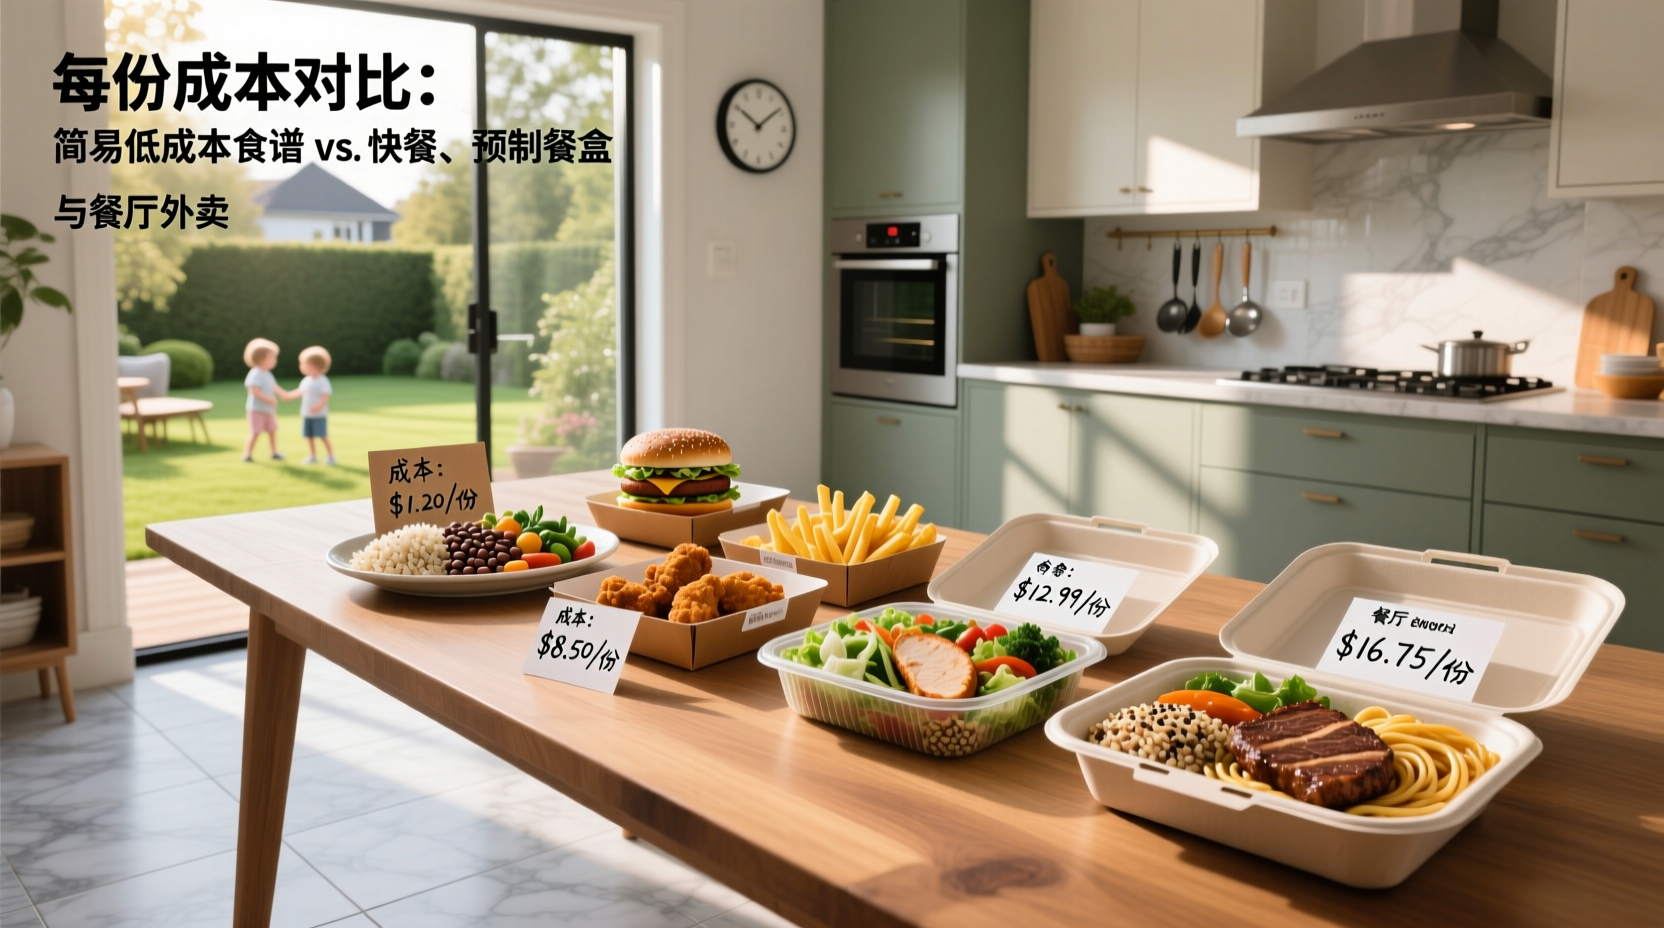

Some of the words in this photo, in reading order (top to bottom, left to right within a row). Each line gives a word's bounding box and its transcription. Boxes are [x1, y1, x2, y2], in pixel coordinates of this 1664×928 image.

[389, 483, 478, 519] $1.20/份
[1013, 577, 1111, 618] $12.99/份
[537, 630, 620, 672] $8.50/份
[1336, 629, 1475, 685] $16.75/份
